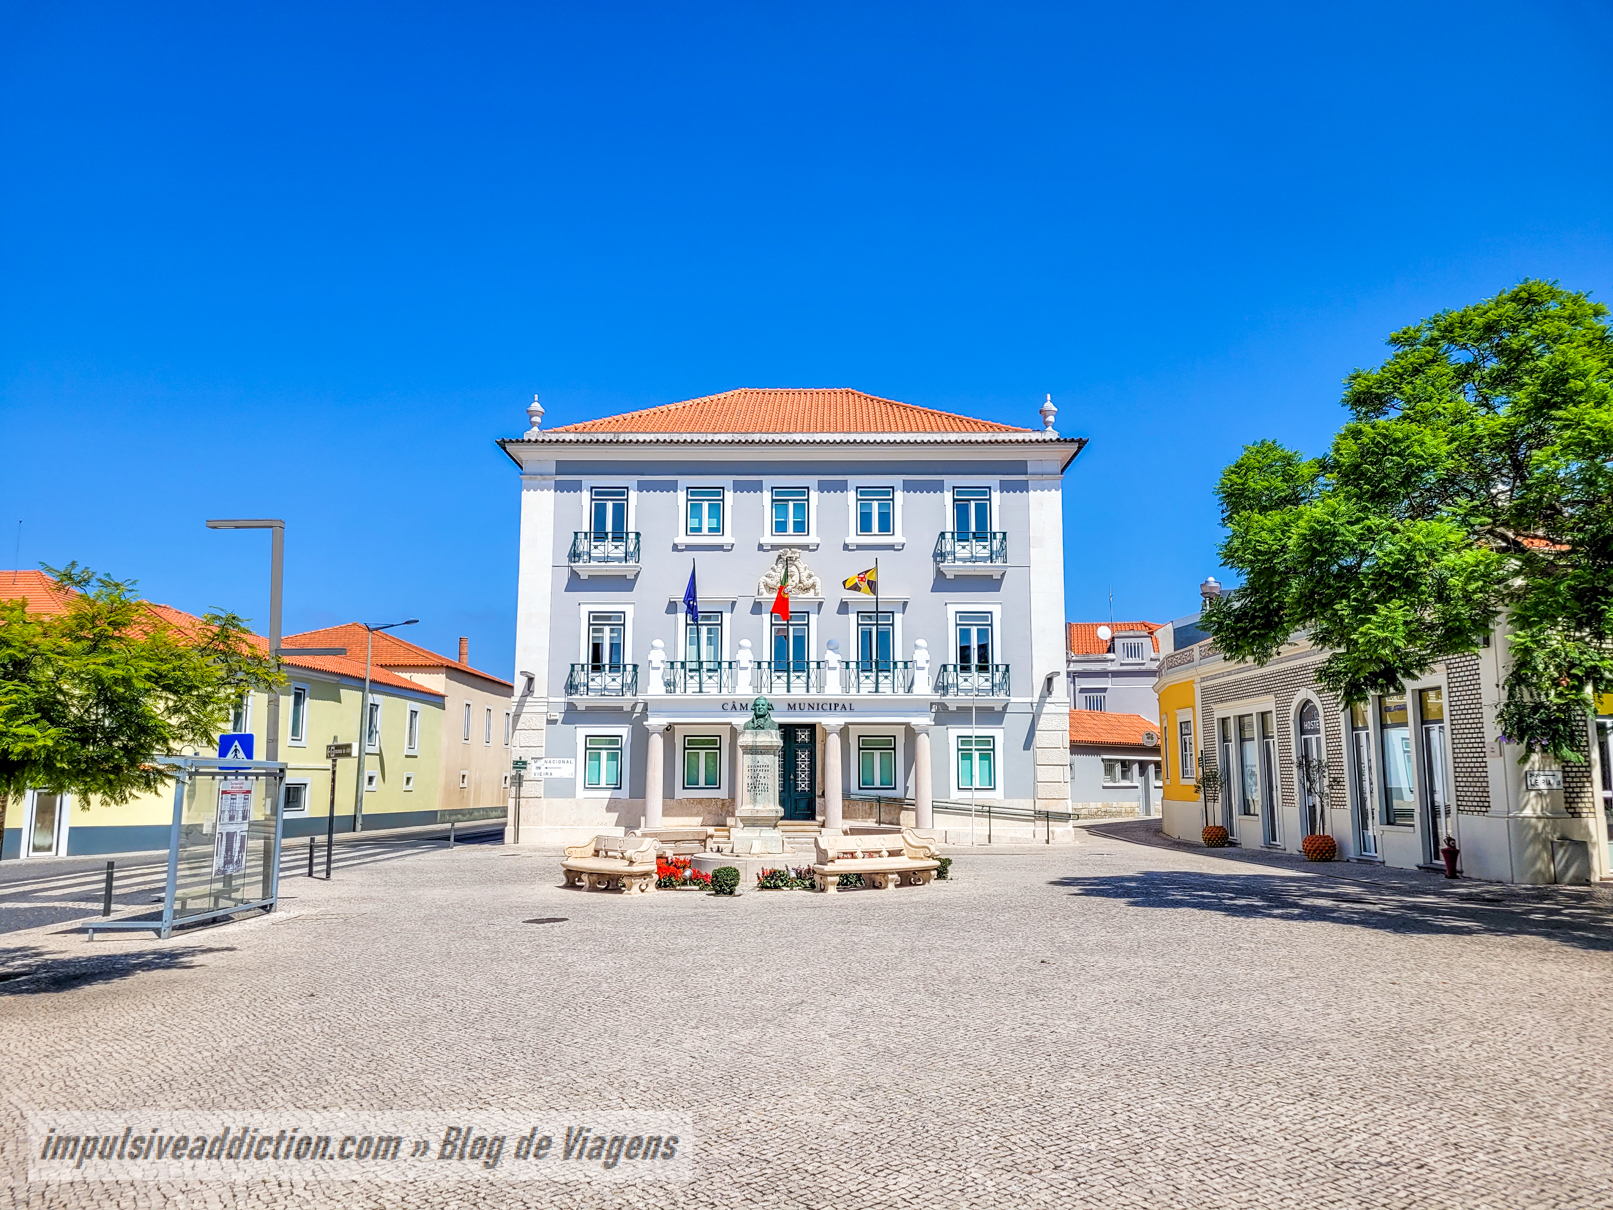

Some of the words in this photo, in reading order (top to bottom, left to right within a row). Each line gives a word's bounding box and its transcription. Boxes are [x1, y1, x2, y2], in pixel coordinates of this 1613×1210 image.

[721, 701, 775, 711] CÂMA
[787, 702, 855, 711] MUNICIPAL
[1303, 720, 1320, 730] HOSTE
